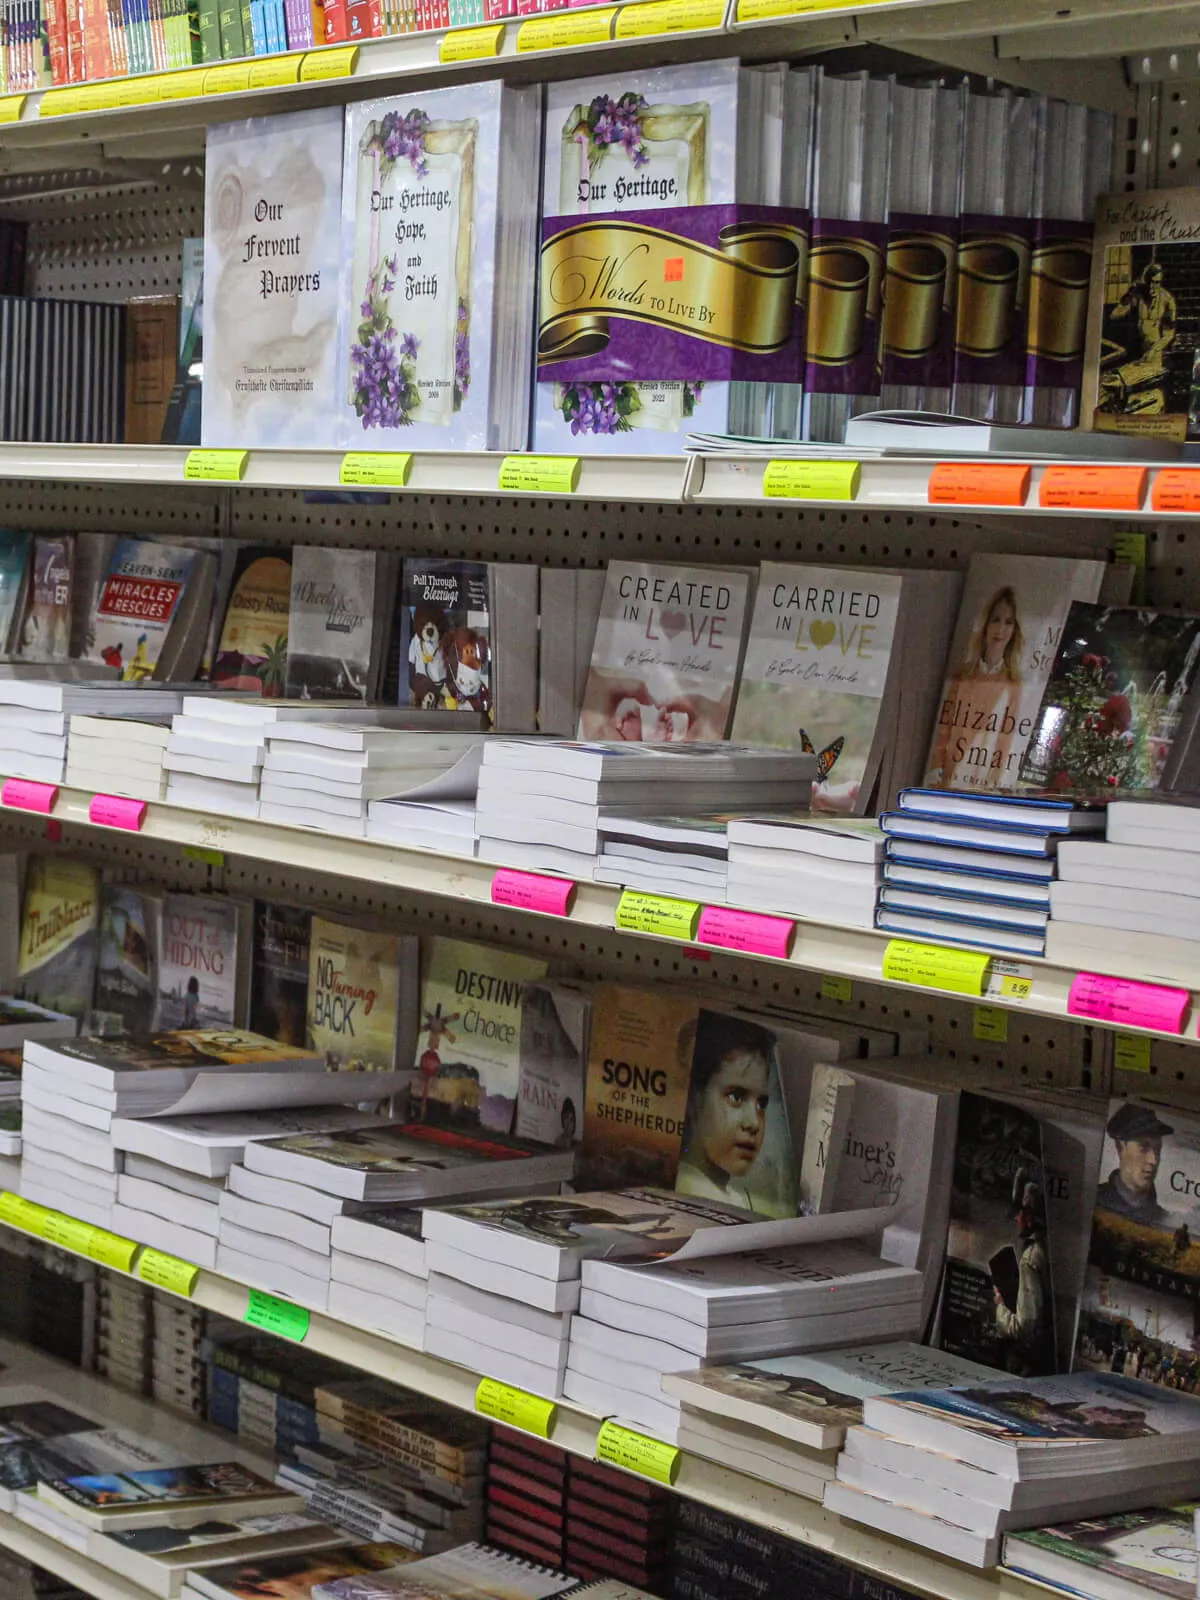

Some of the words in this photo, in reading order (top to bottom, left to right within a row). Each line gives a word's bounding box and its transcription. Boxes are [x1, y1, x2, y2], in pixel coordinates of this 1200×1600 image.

[370, 190, 395, 212] Our
[400, 187, 452, 213] Heritage,
[577, 178, 607, 201] Our
[613, 175, 679, 202] Heritage,
[255, 200, 283, 223] Our
[395, 220, 427, 243] Hope,
[1158, 217, 1200, 241] Churc
[243, 235, 300, 263] Fervent
[407, 255, 422, 268] and
[260, 271, 321, 299] Prayers
[405, 274, 439, 300] Faith
[550, 244, 649, 309] Words
[108, 581, 175, 603] MIRACLES
[412, 574, 427, 587] Pull
[427, 575, 457, 591] Through
[618, 575, 731, 611] CREATED
[113, 597, 166, 618] RESCUES
[422, 586, 460, 608] Blessings
[773, 583, 881, 620] CARRIED
[623, 605, 640, 621] IN
[776, 616, 792, 631] IN
[1046, 626, 1060, 645] M
[938, 704, 1033, 739] Elizabe
[951, 737, 1023, 771] Smart
[169, 913, 206, 943] OUT
[163, 937, 224, 976] HIDING
[317, 955, 334, 990] NO
[332, 971, 377, 1016] Turning
[455, 968, 522, 1009] DESTINY
[314, 990, 357, 1038] BACK
[463, 1008, 516, 1044] Choice
[601, 1058, 668, 1098] SONG
[611, 1089, 626, 1101] OF
[629, 1092, 650, 1109] THE
[596, 1102, 686, 1137] SHEPHERDE
